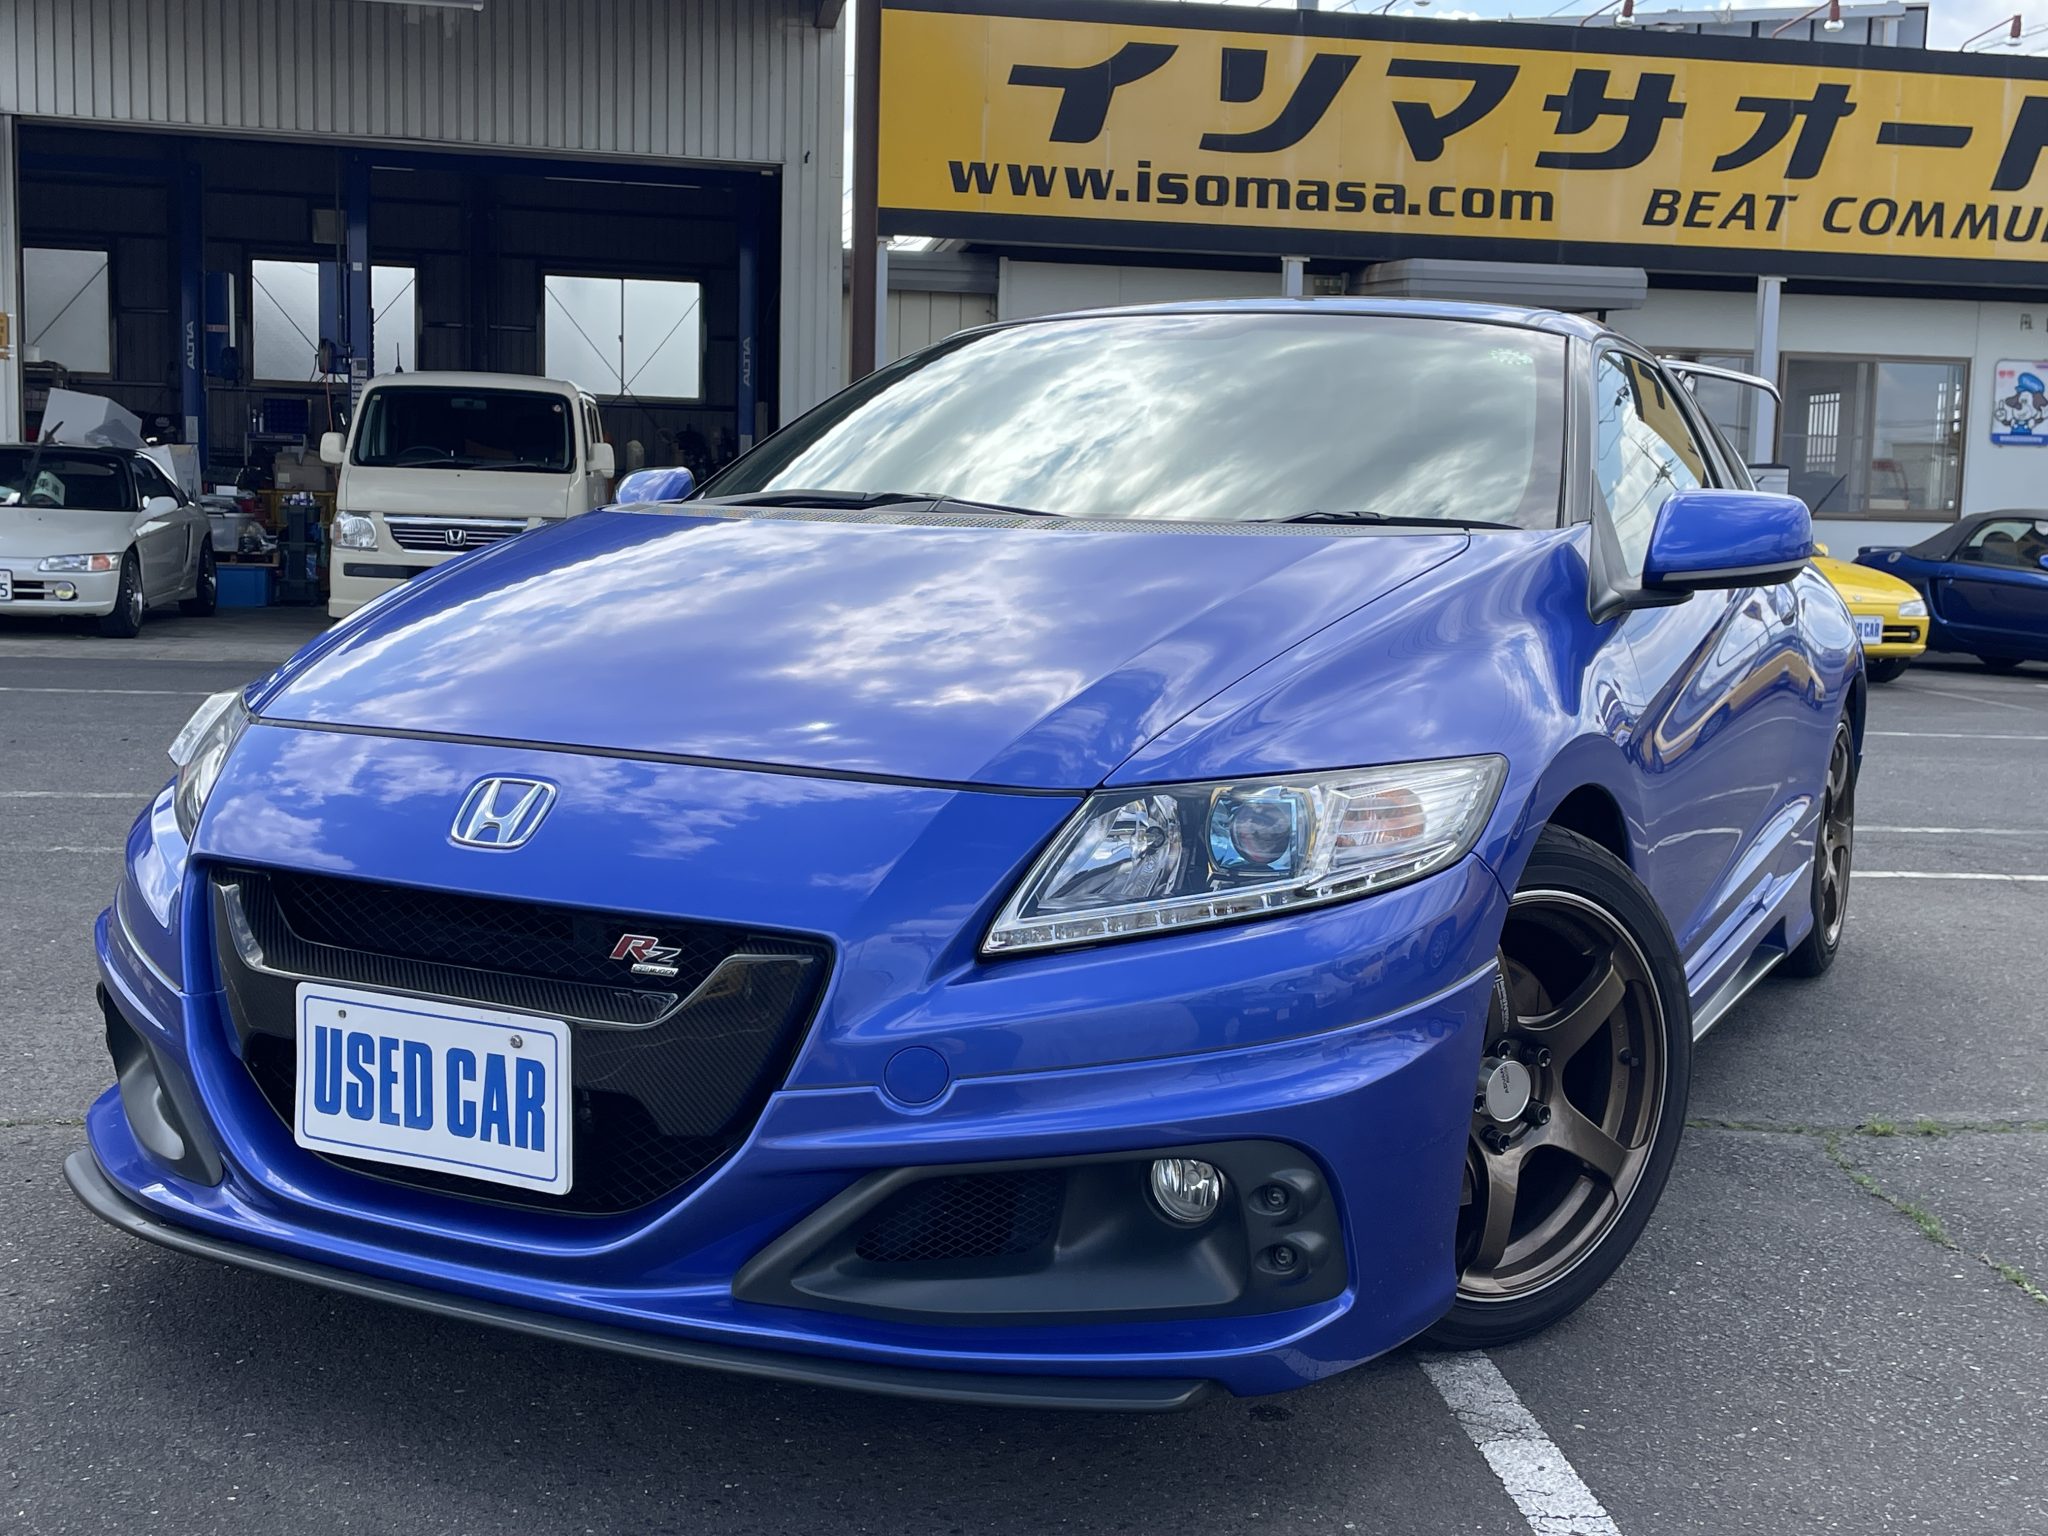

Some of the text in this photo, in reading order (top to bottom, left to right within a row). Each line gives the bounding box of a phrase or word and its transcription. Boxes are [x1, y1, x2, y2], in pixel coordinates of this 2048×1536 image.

[948, 160, 1554, 222] www.isomasa.com
[1642, 188, 2048, 243] BEAT COMMU
[1864, 622, 1880, 637] CAR
[314, 1025, 545, 1152] USED CAR
